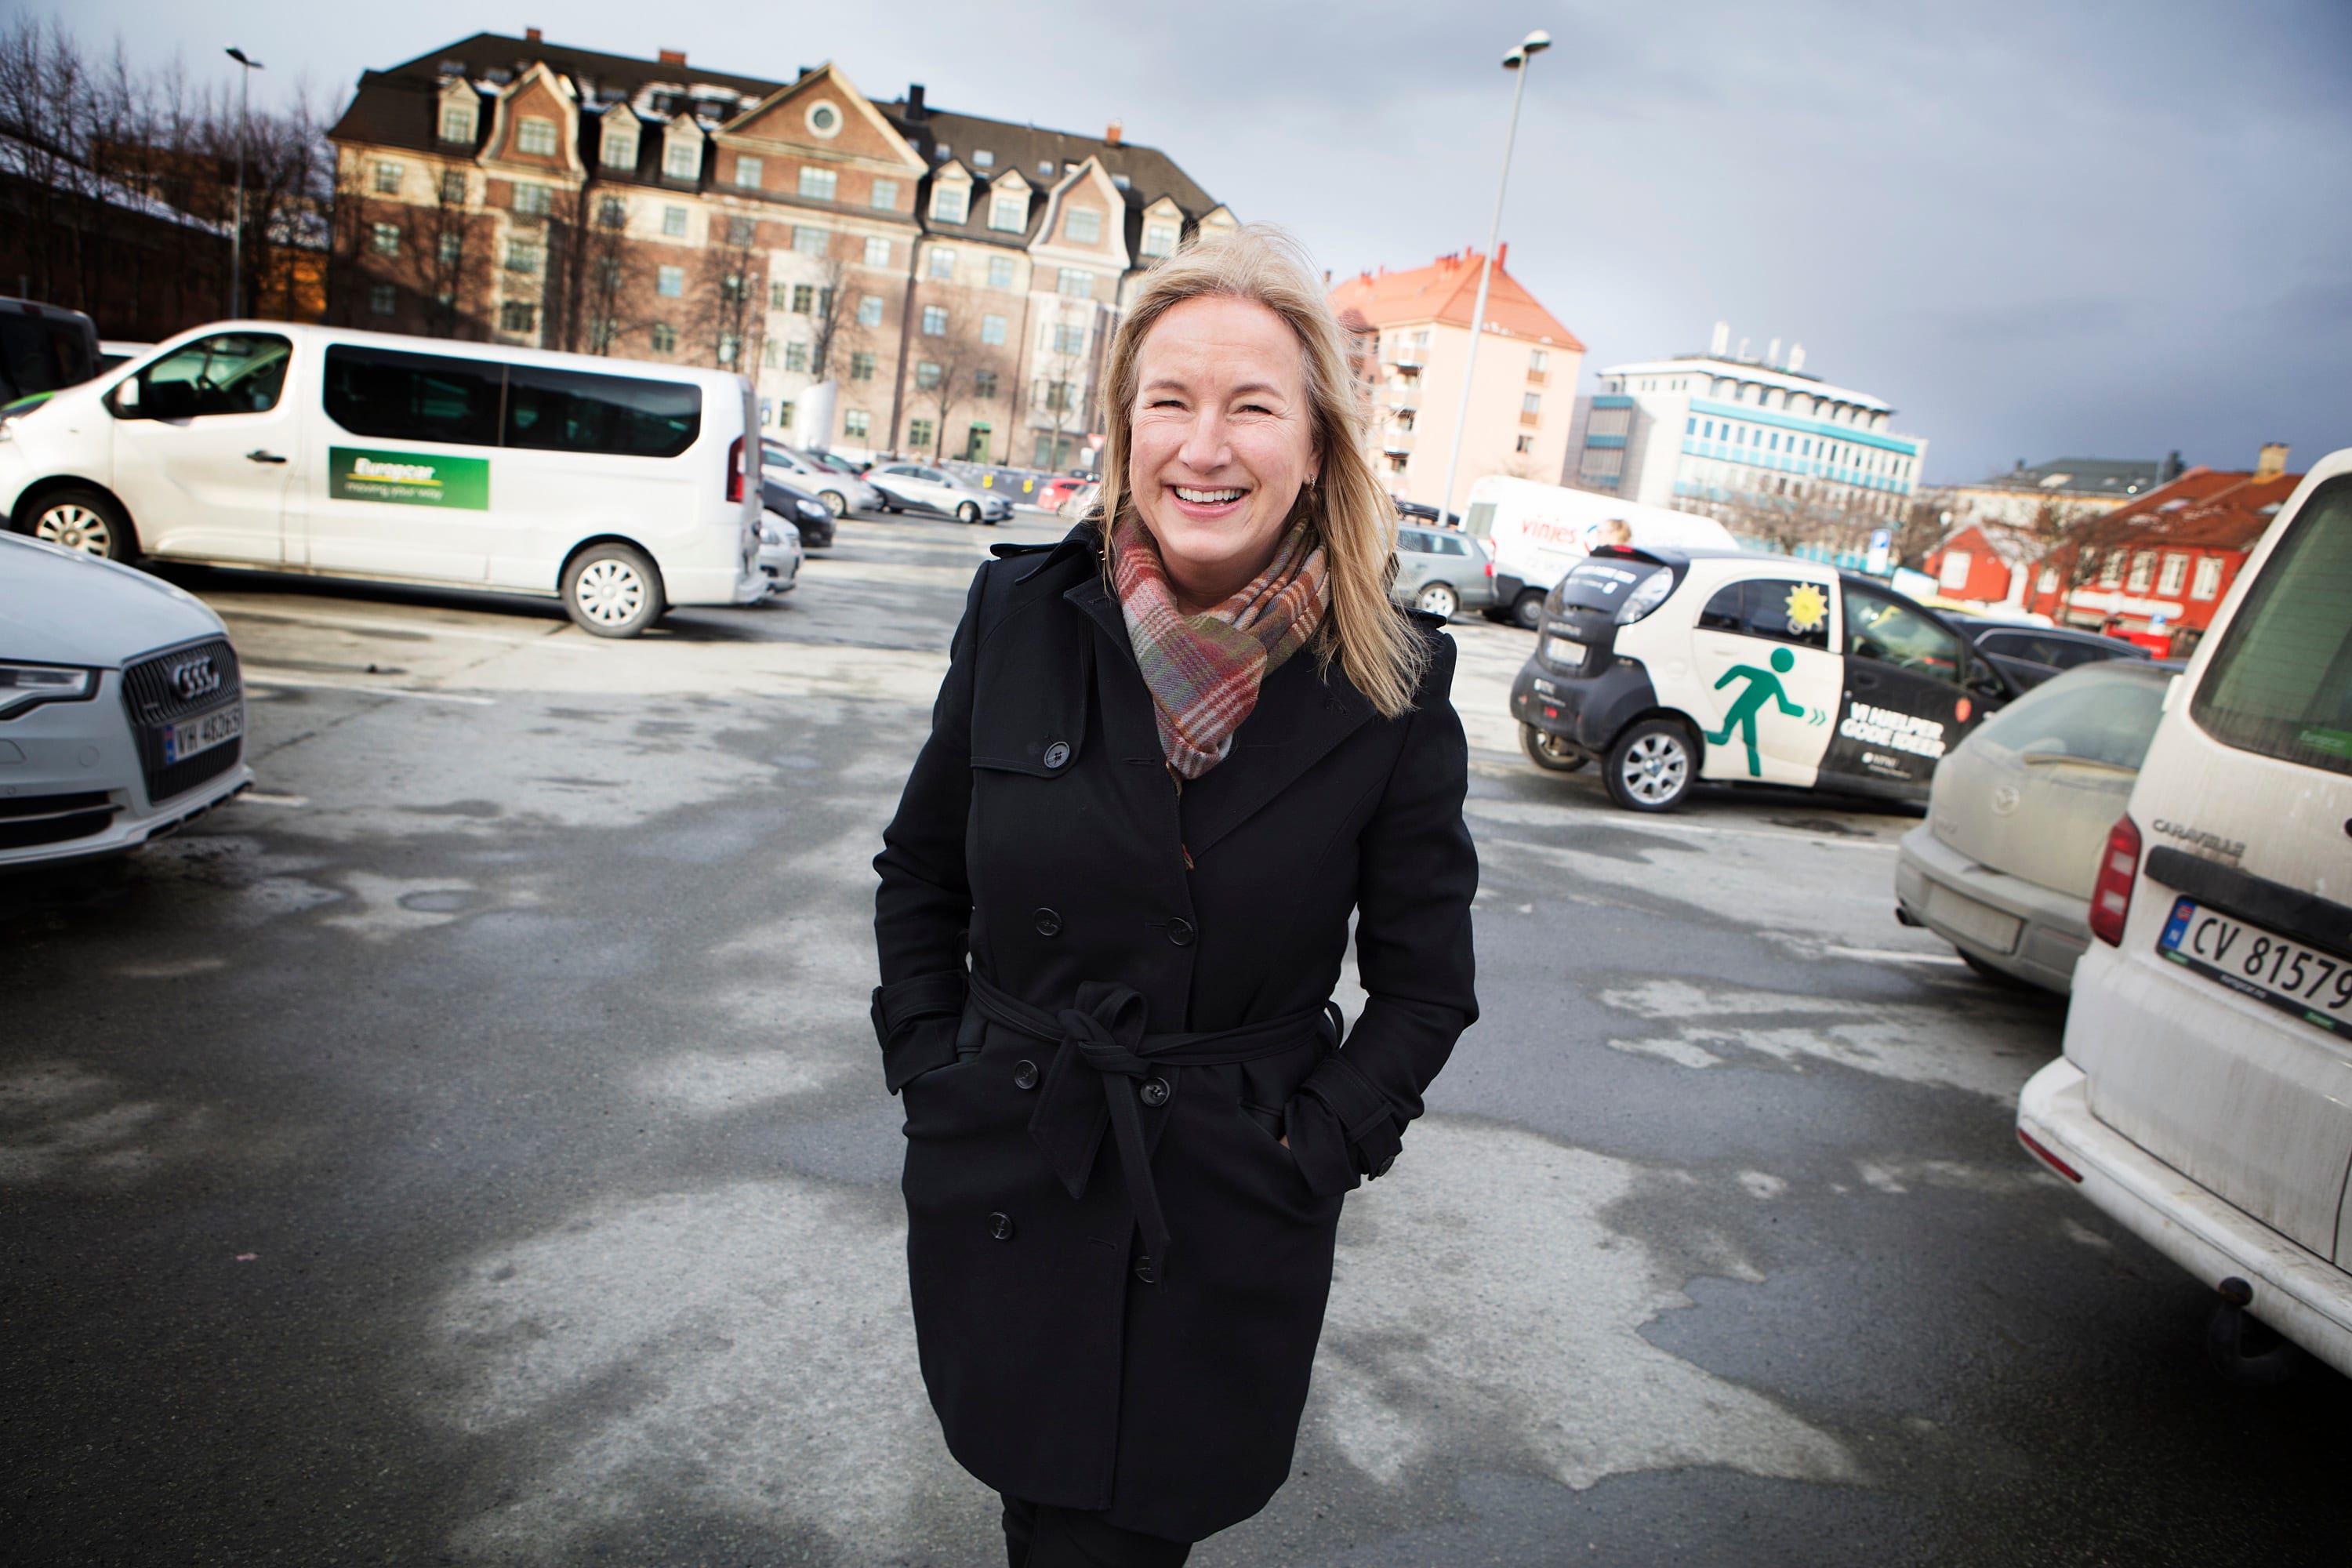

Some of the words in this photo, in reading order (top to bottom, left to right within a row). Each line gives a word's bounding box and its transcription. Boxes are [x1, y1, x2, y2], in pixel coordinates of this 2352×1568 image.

[354, 457, 435, 482] Europcar
[345, 481, 390, 499] moving
[1522, 514, 1577, 544] vinjes
[2152, 818, 2246, 858] CARAVELLE
[2194, 916, 2241, 961] CV
[2243, 936, 2352, 1010] 81579
